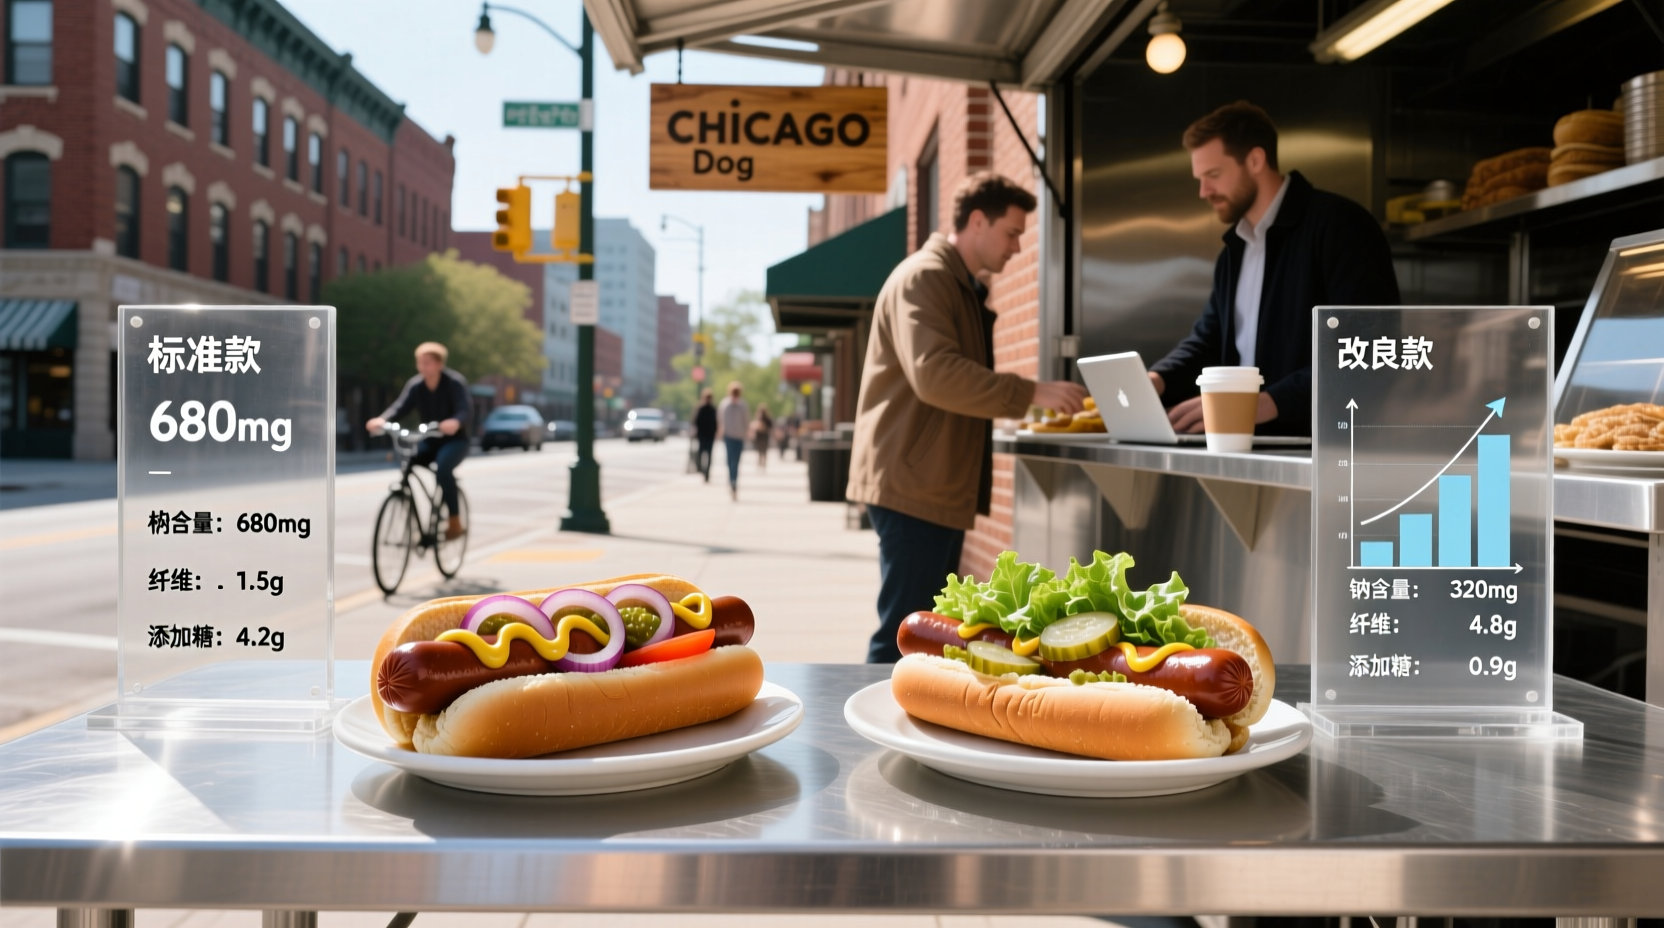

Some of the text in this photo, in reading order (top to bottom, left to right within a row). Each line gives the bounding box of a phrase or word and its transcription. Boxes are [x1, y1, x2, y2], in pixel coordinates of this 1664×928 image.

[693, 149, 754, 182] Dog
[147, 335, 262, 375] 标准款
[1337, 335, 1434, 371] 改良款
[149, 400, 292, 452] 680mg
[236, 512, 311, 539] 680mg
[236, 570, 284, 596] 1.5g
[1449, 579, 1518, 605] 320mg
[235, 626, 285, 652] 4.2g
[1468, 614, 1517, 641] 4.8g
[1468, 656, 1517, 681] 0.9g
